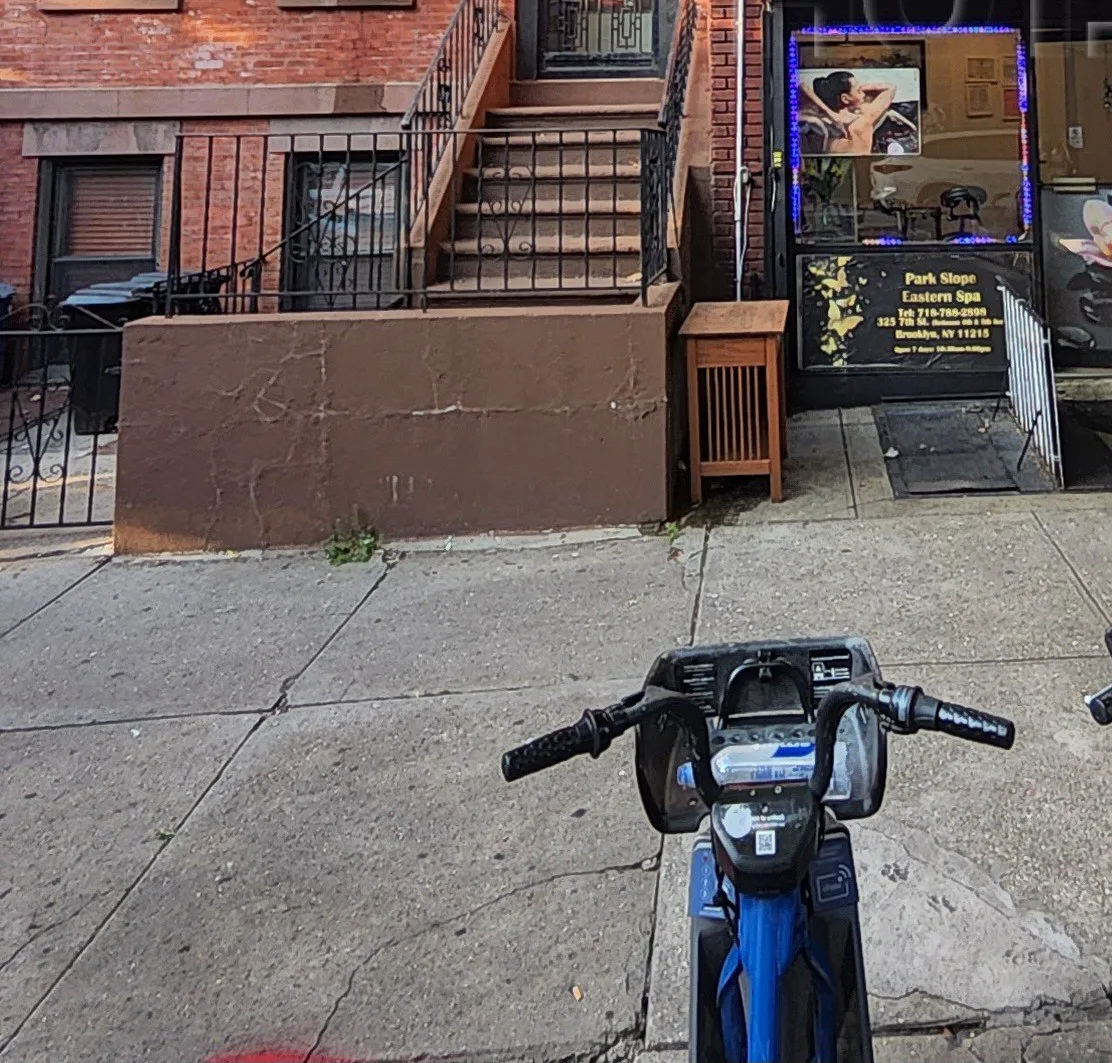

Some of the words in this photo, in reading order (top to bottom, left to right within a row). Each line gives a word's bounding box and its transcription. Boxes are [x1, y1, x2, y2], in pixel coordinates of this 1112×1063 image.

[905, 272, 937, 285] Park
[940, 272, 977, 286] Slope
[902, 290, 952, 303] Eastern
[956, 289, 981, 304] Spa
